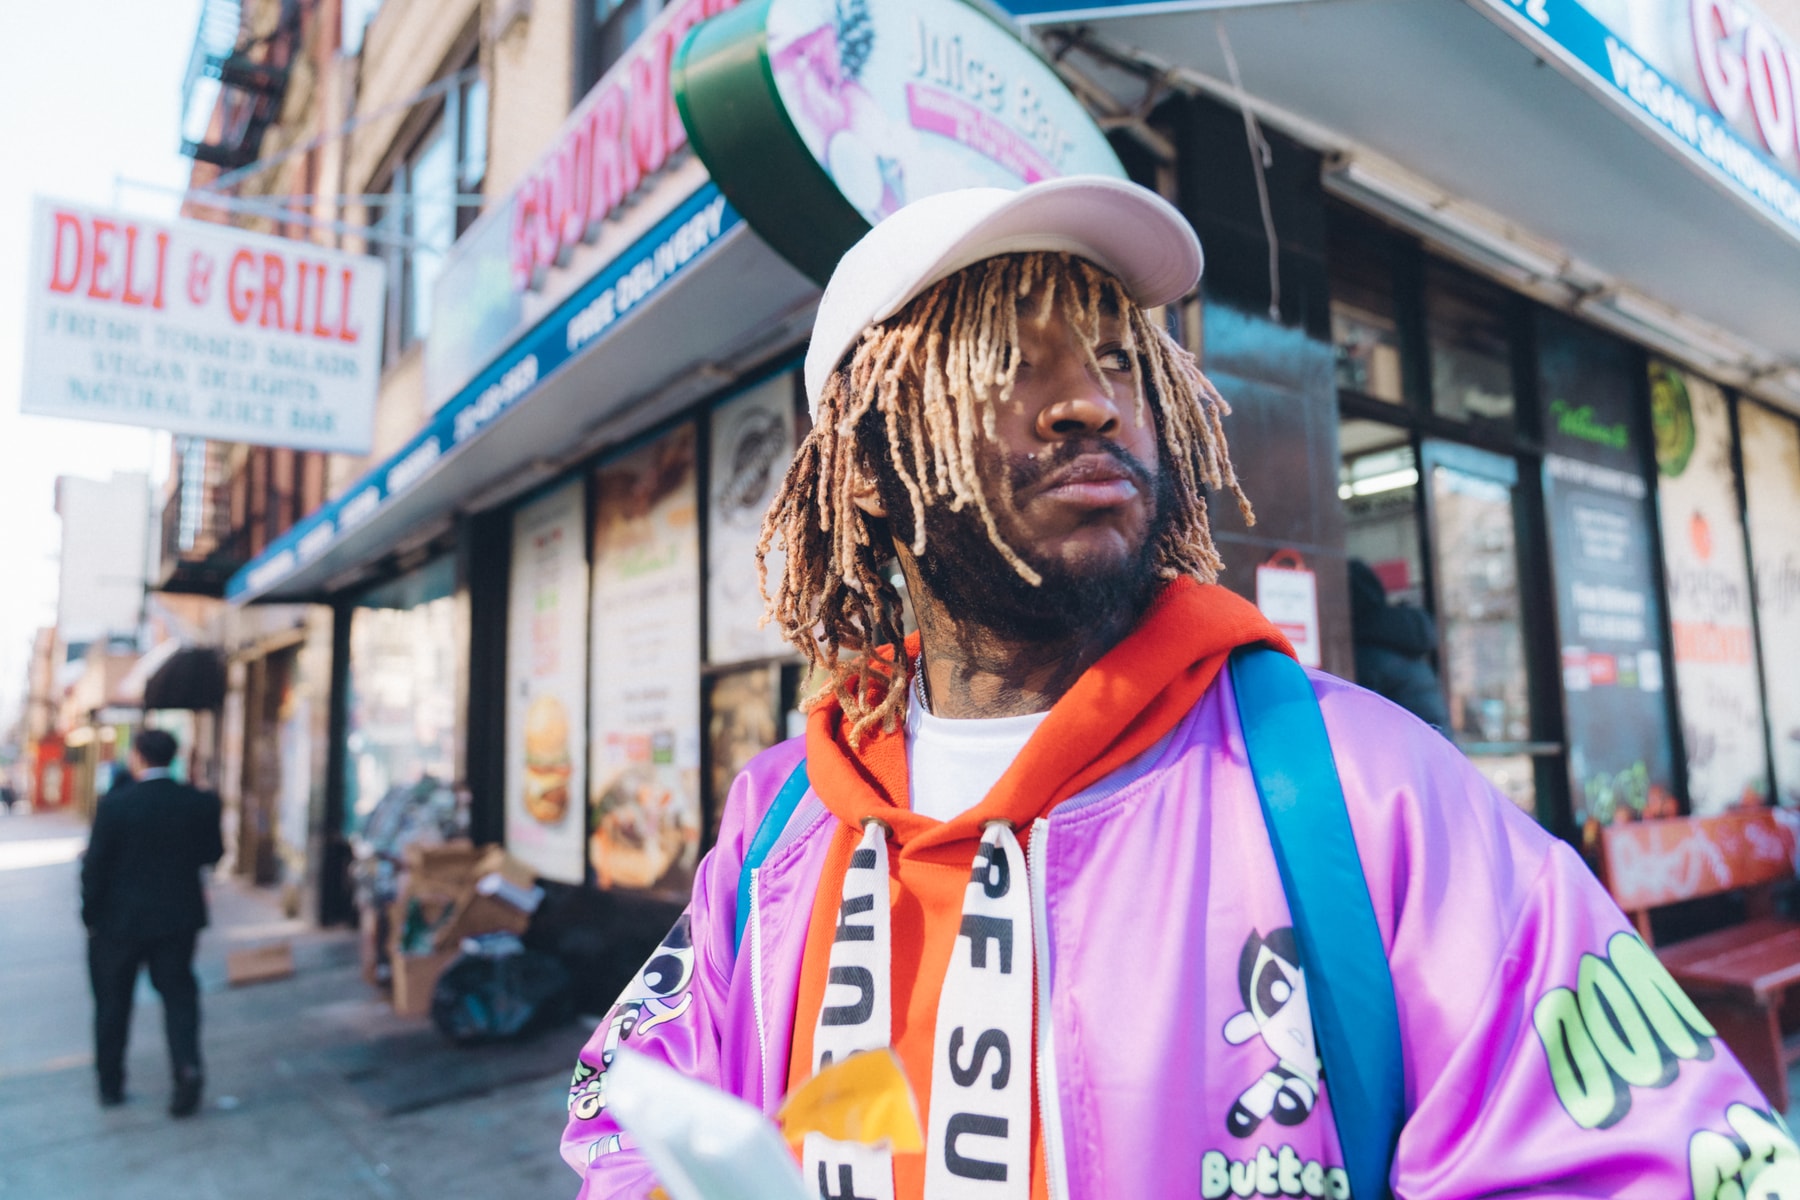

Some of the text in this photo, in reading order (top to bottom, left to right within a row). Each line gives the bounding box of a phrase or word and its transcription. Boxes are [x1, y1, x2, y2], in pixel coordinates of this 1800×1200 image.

[903, 14, 1005, 114] Juice
[1013, 76, 1077, 168] Bar
[1604, 36, 1699, 146] VEGAN
[49, 212, 359, 343] DELI & GRILL
[615, 193, 727, 313] DELIVERY
